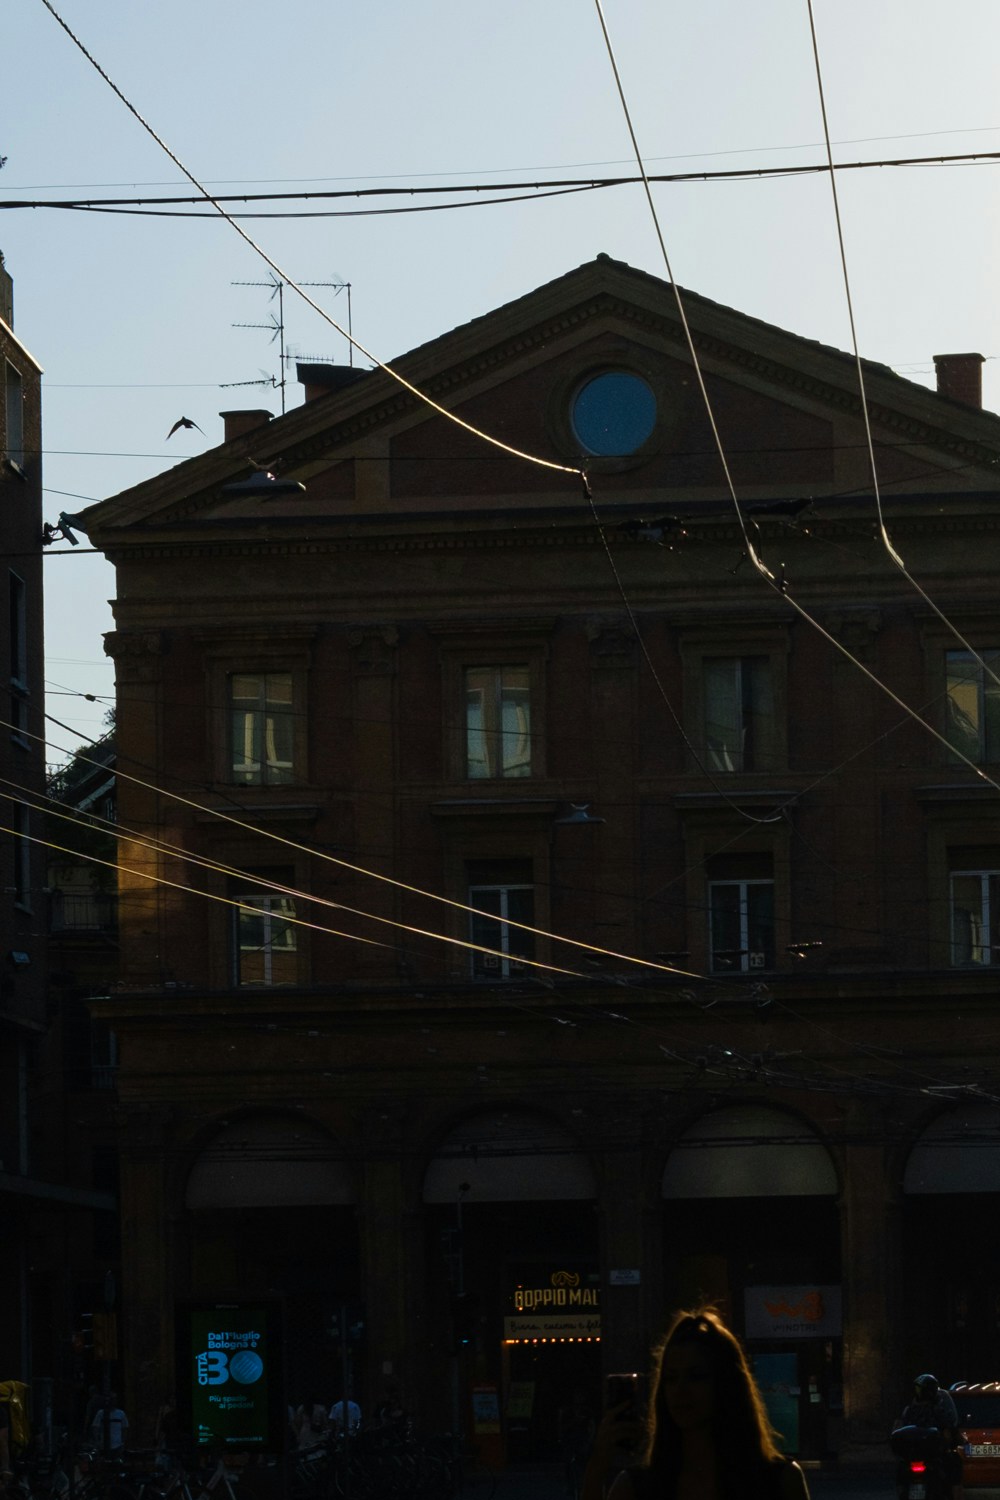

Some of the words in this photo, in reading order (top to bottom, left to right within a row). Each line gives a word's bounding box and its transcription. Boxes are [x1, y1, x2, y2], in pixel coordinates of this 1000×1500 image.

[752, 956, 764, 965] 13
[569, 1288, 600, 1306] MAL
[208, 1332, 224, 1340] Dal
[233, 1331, 261, 1342] luglio
[208, 1340, 249, 1350] Bologna
[195, 1351, 208, 1386] CITTÀ
[208, 1350, 264, 1385] 30
